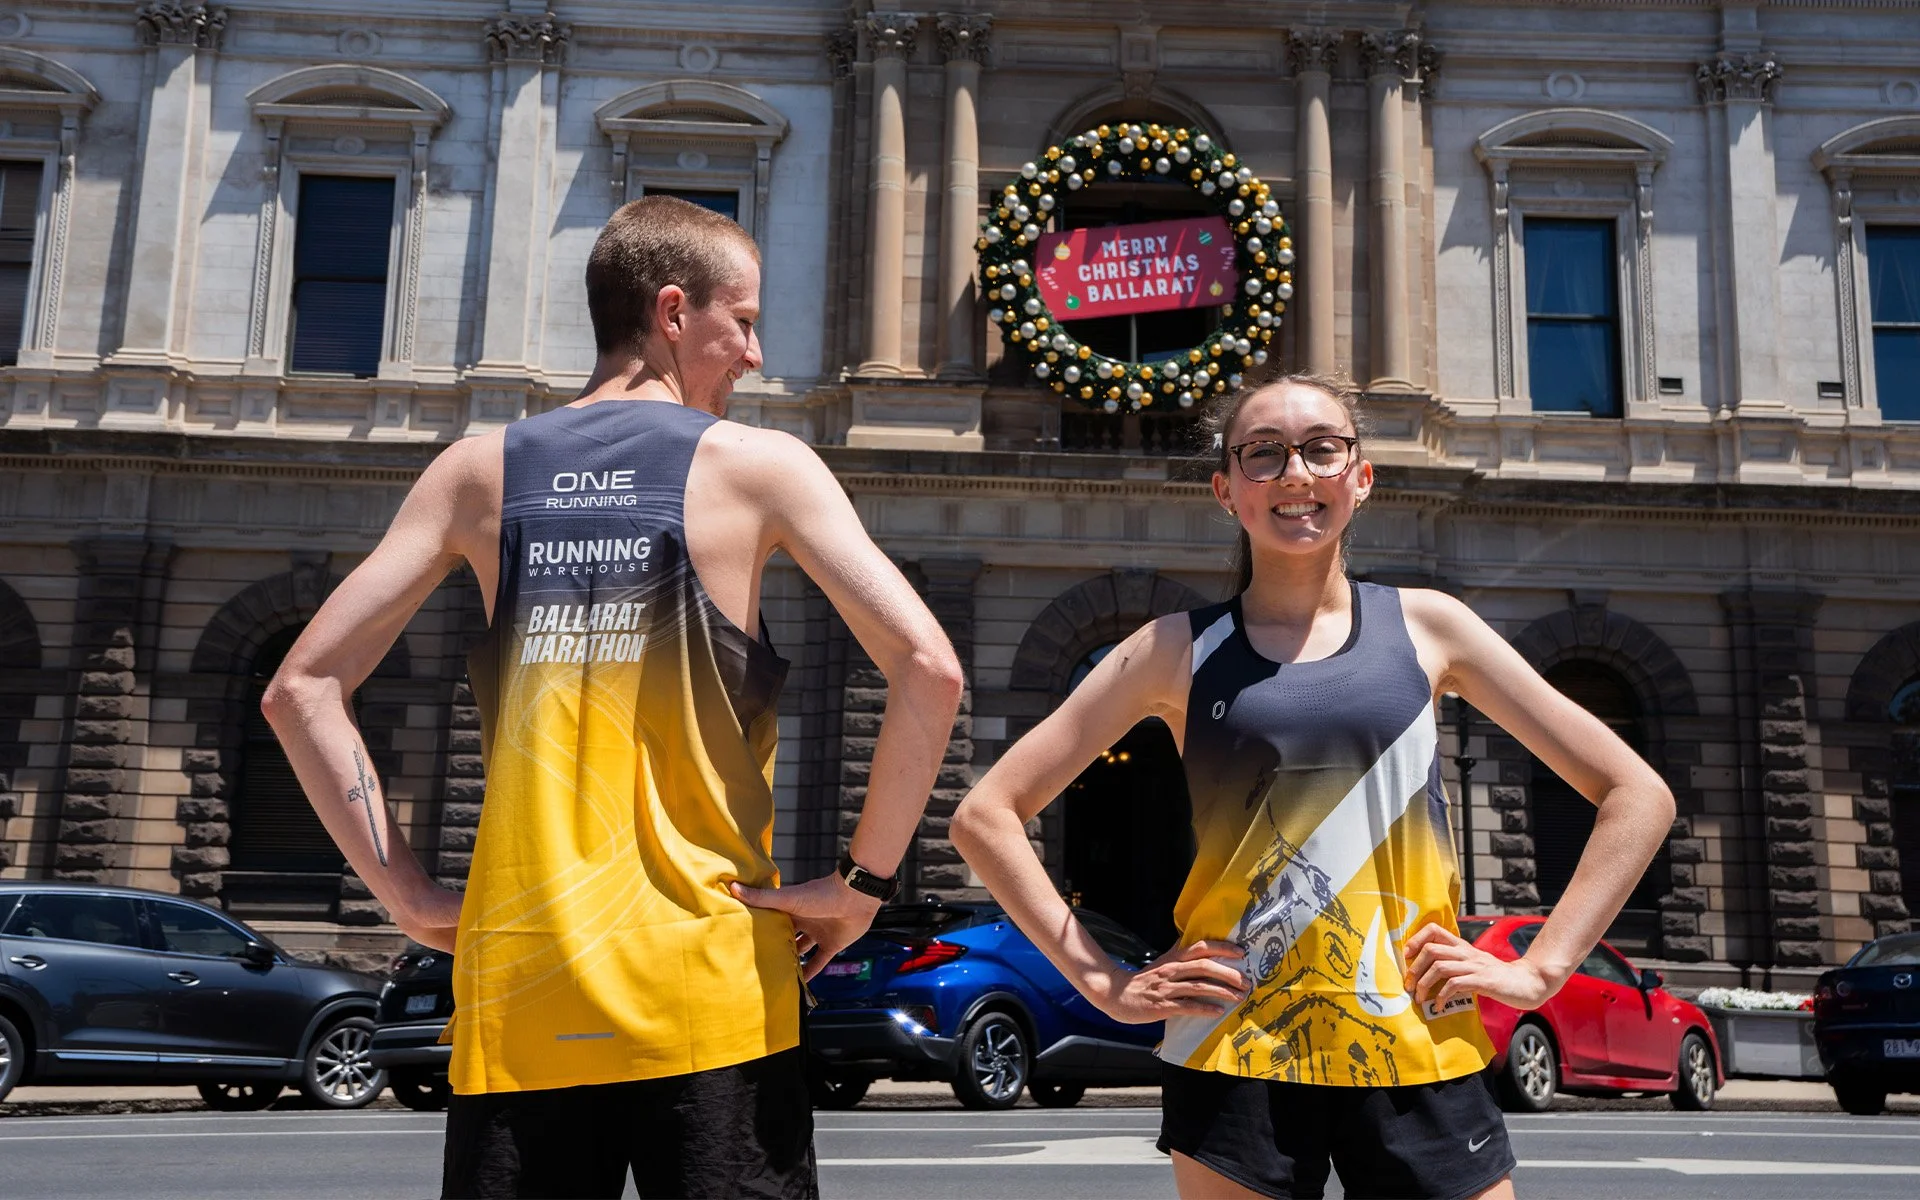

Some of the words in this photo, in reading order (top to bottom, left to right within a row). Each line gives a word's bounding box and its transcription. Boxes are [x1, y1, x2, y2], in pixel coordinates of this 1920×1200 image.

[1102, 236, 1168, 258] MERRY
[1078, 254, 1200, 282] CHRISTMAS
[1087, 276, 1196, 303] BALLARAT
[552, 470, 636, 492] ONE
[546, 494, 637, 509] RUNNING
[528, 537, 651, 565] RUNNING
[528, 562, 649, 577] WAREHOUSE
[527, 602, 646, 634] BALLARAT
[520, 634, 646, 665] MARATHON
